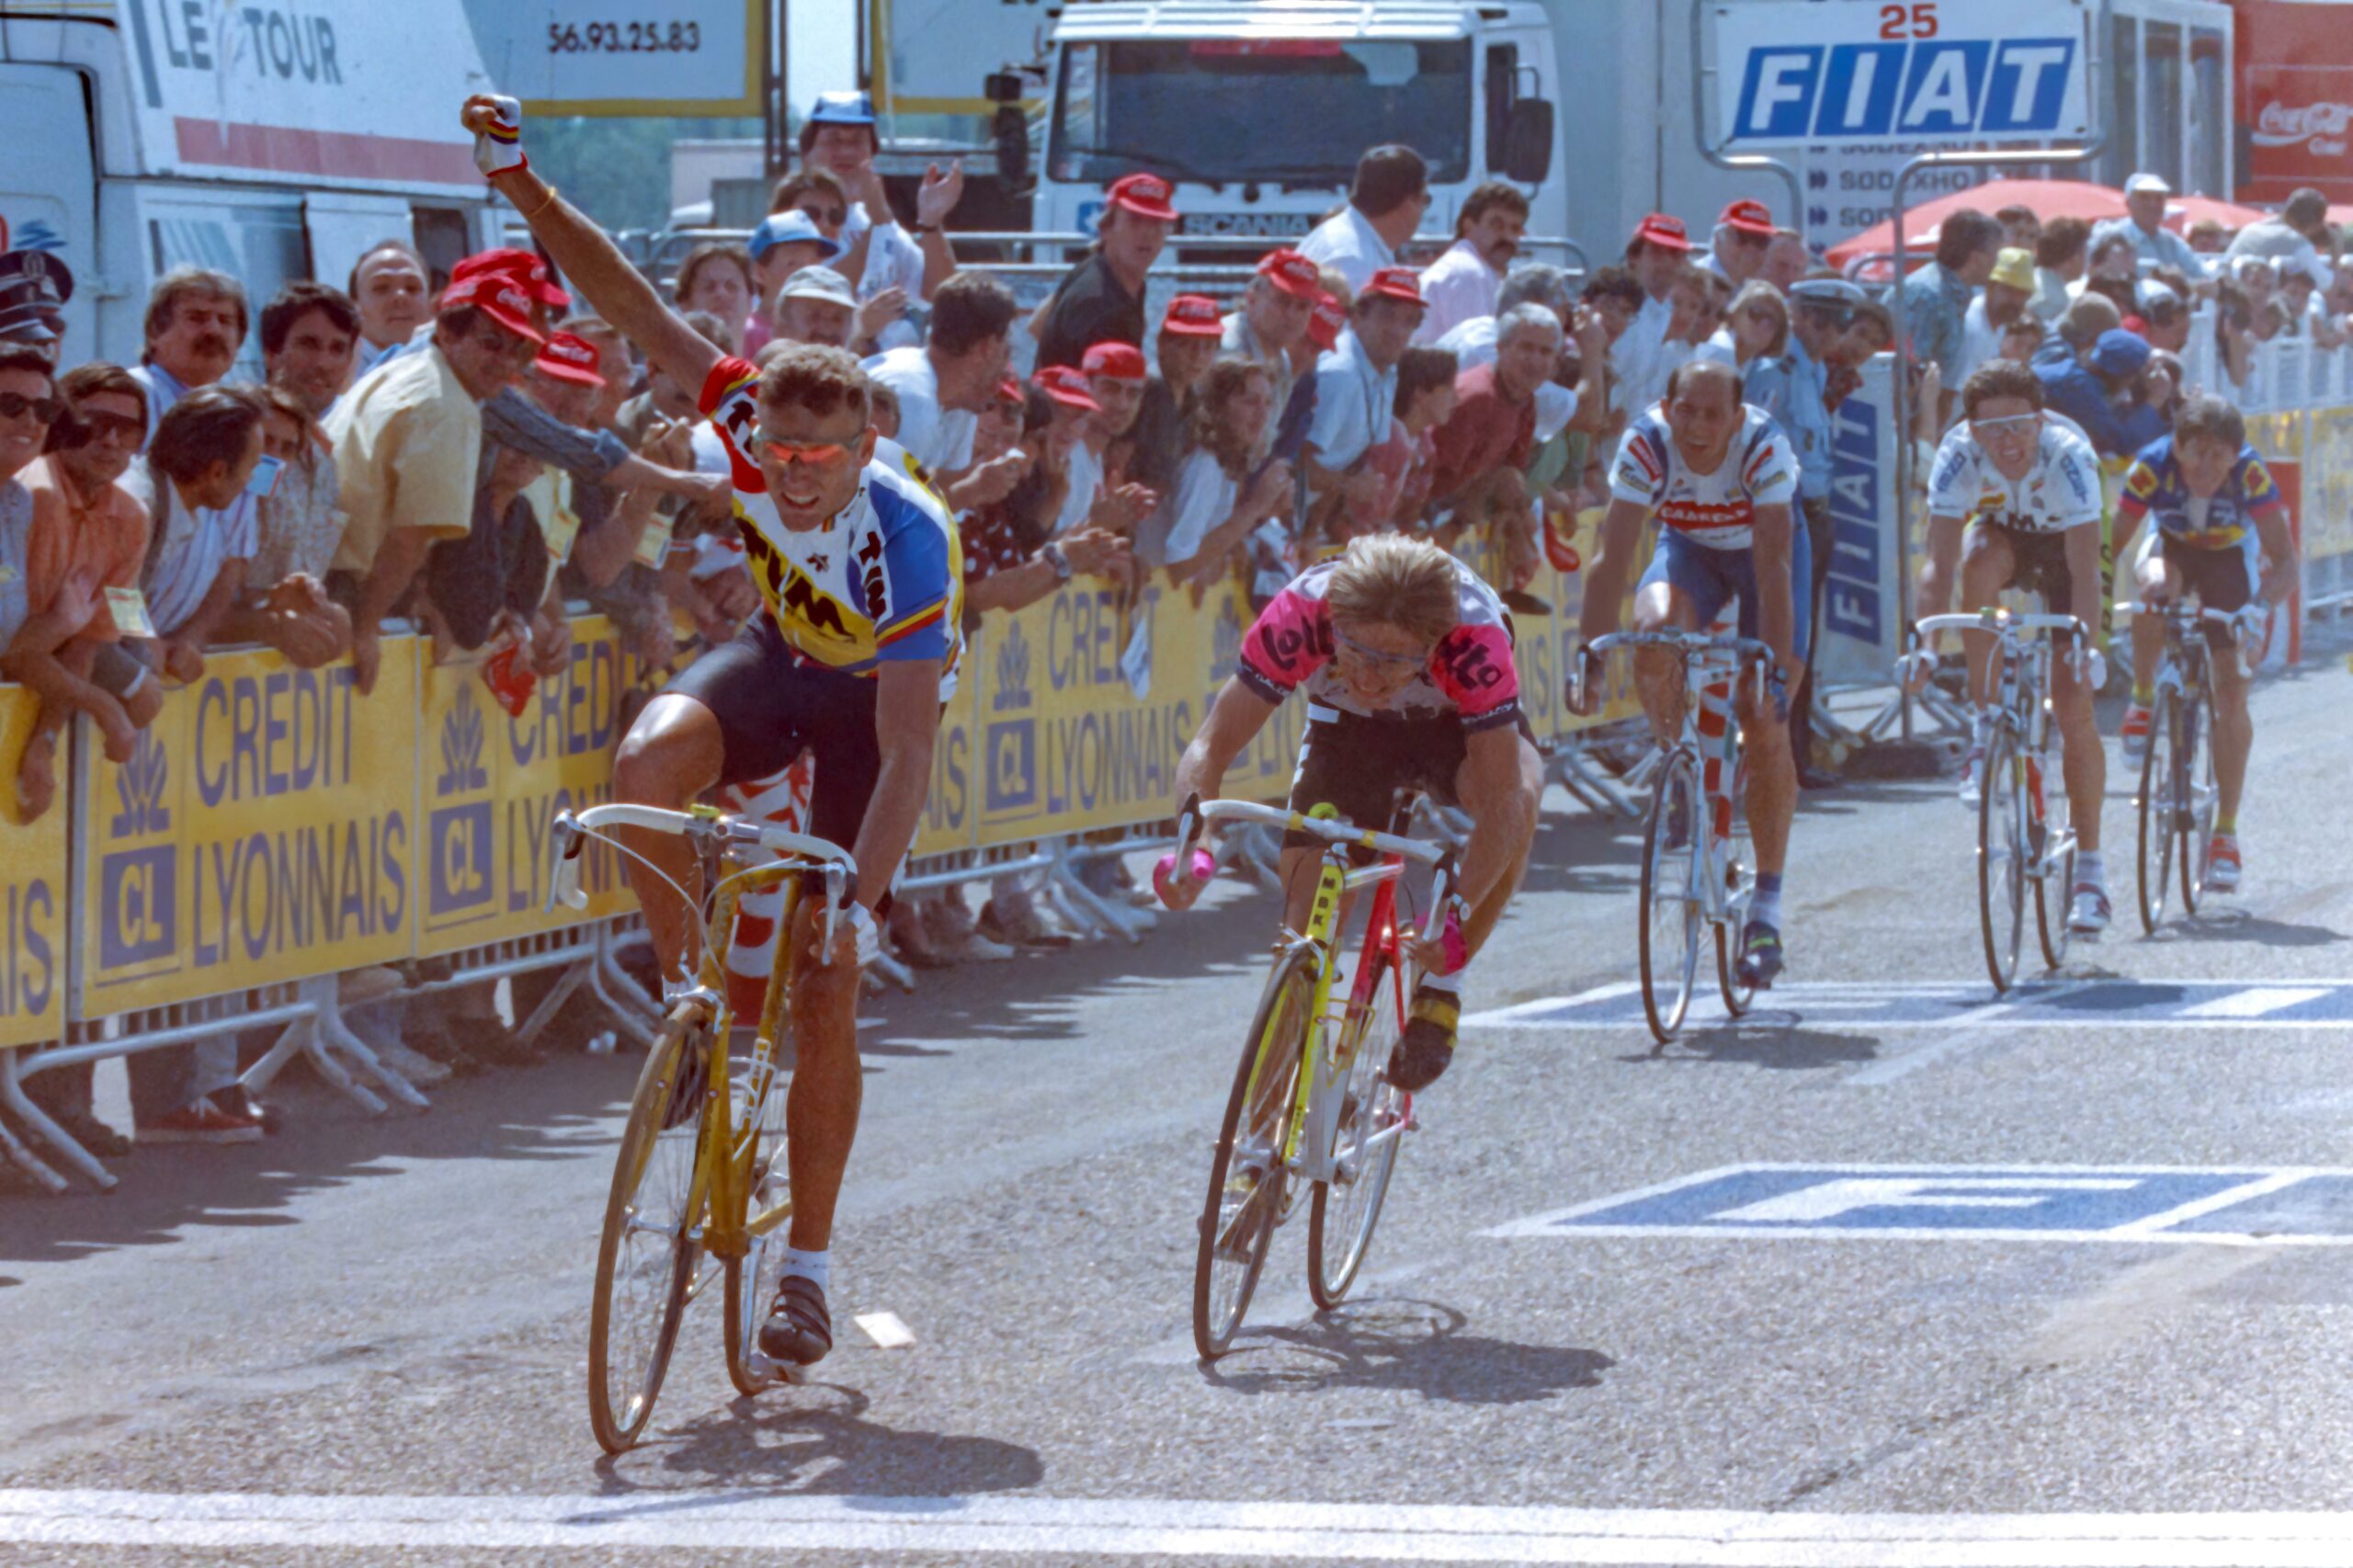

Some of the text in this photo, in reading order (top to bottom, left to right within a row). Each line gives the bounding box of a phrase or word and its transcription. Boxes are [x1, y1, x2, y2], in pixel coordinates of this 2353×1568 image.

[158, 0, 343, 85] LE TOUR
[548, 21, 700, 54] 56.93.25.83
[1879, 5, 1938, 40] 25
[1748, 46, 2066, 131] FIAT
[1839, 169, 1970, 191] SODXHO
[1185, 214, 1309, 236] SCANIA
[1833, 410, 1874, 627] FIAT
[196, 666, 358, 808] CREDIT
[193, 810, 405, 968] LYONNAIS
[445, 818, 483, 897] CL
[119, 861, 164, 949] CL
